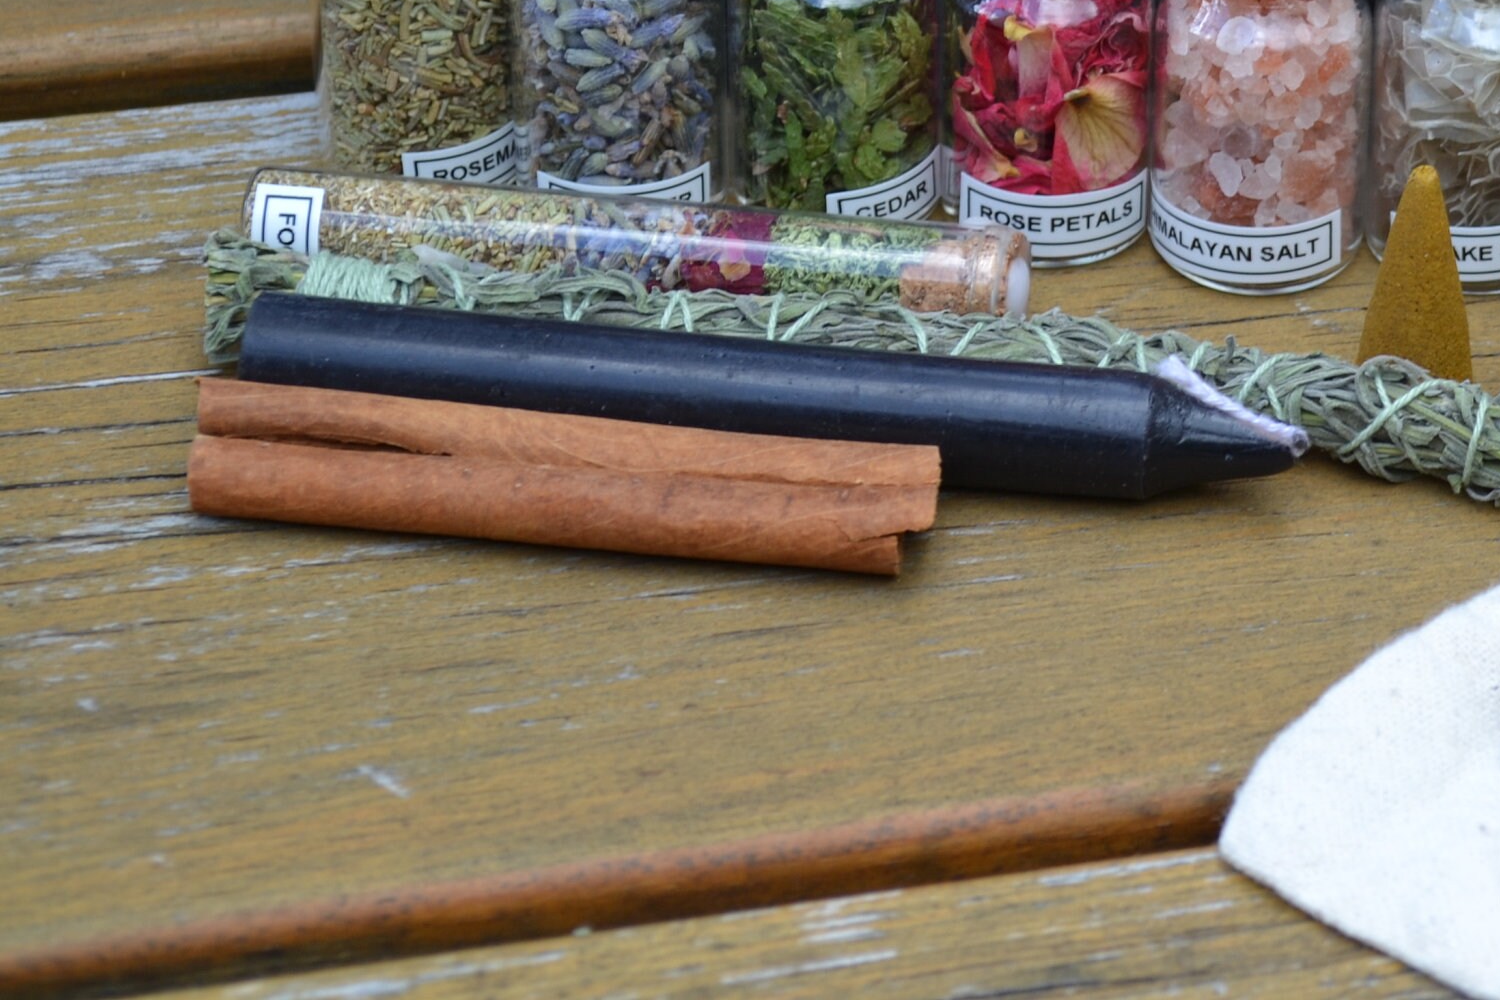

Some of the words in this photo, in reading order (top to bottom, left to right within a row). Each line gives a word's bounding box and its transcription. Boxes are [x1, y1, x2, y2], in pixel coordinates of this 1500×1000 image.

[277, 213, 297, 250] FO
[980, 205, 1042, 232] ROSE
[1050, 200, 1133, 232] PETALS
[1260, 237, 1319, 262] SALT
